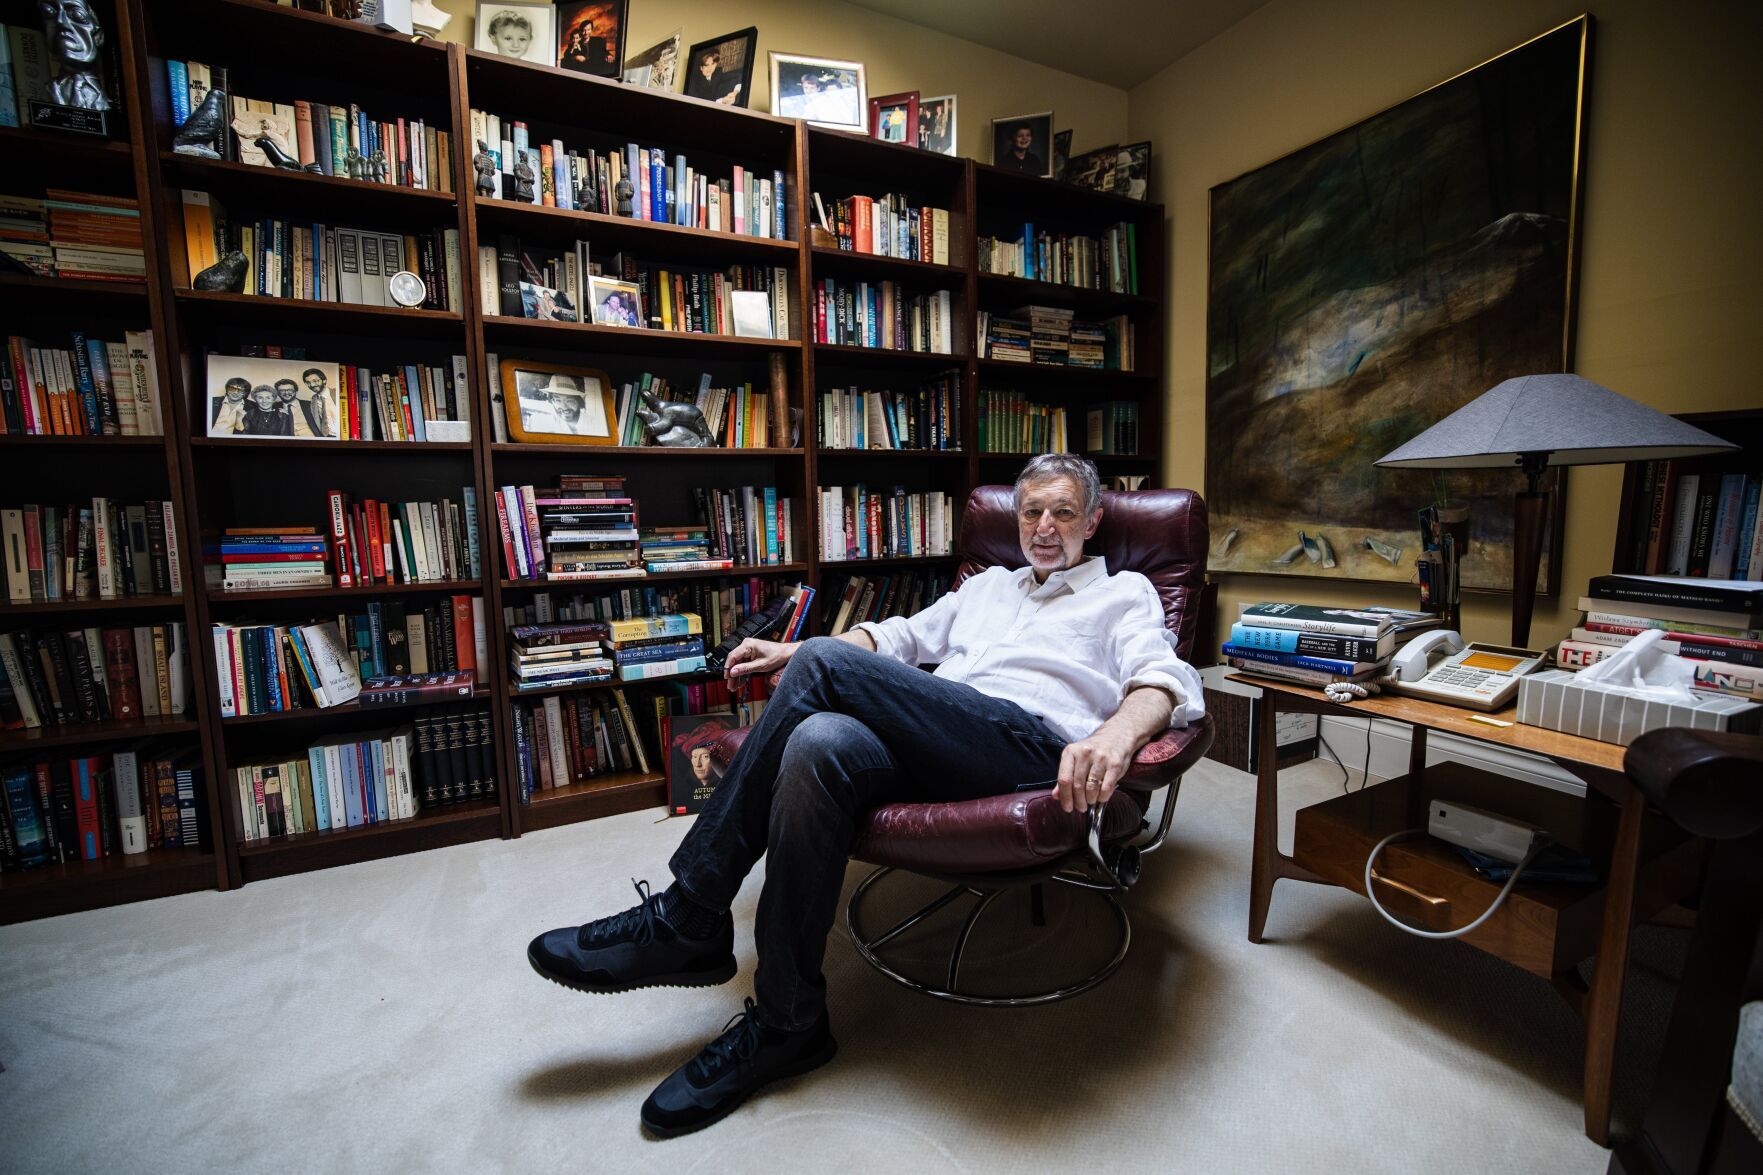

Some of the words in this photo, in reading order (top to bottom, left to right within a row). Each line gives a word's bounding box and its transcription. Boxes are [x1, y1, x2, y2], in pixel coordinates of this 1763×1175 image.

[690, 274, 699, 293] Philip
[74, 334, 88, 366] Sebastian
[79, 366, 89, 384] Barry
[102, 400, 110, 416] END
[88, 415, 96, 429] Time
[332, 496, 341, 520] CAHOKIA
[526, 501, 534, 514] Ibn
[1651, 485, 1665, 528] MYTHOLOGY
[1705, 495, 1713, 508] ONE
[164, 504, 173, 530] ALEJANDRO
[499, 508, 511, 543] FIREARMS
[1702, 509, 1711, 525] WHO
[96, 527, 104, 544] FINAL
[335, 521, 343, 534] JAZZ
[528, 516, 540, 548] Khaldun
[1698, 526, 1708, 548] KNOWS
[97, 545, 106, 567] DECREE
[1697, 549, 1704, 558] ME
[443, 608, 452, 645] BERNARD
[617, 629, 646, 637] Corrupting
[1303, 621, 1336, 632] Storylife
[1609, 626, 1643, 636] ATGET'S
[1680, 646, 1710, 656] WITHOUT
[1712, 649, 1727, 657] END
[1729, 640, 1758, 650] TASCHEN
[158, 650, 166, 674] SMALL
[1226, 647, 1255, 658] MEDIEVAL
[1256, 652, 1279, 661] BODIES
[1562, 647, 1592, 666] THE
[1310, 662, 1336, 671] HARTNELL
[81, 678, 94, 707] PEARS
[159, 675, 168, 700] ISLAND
[37, 771, 45, 781] THE
